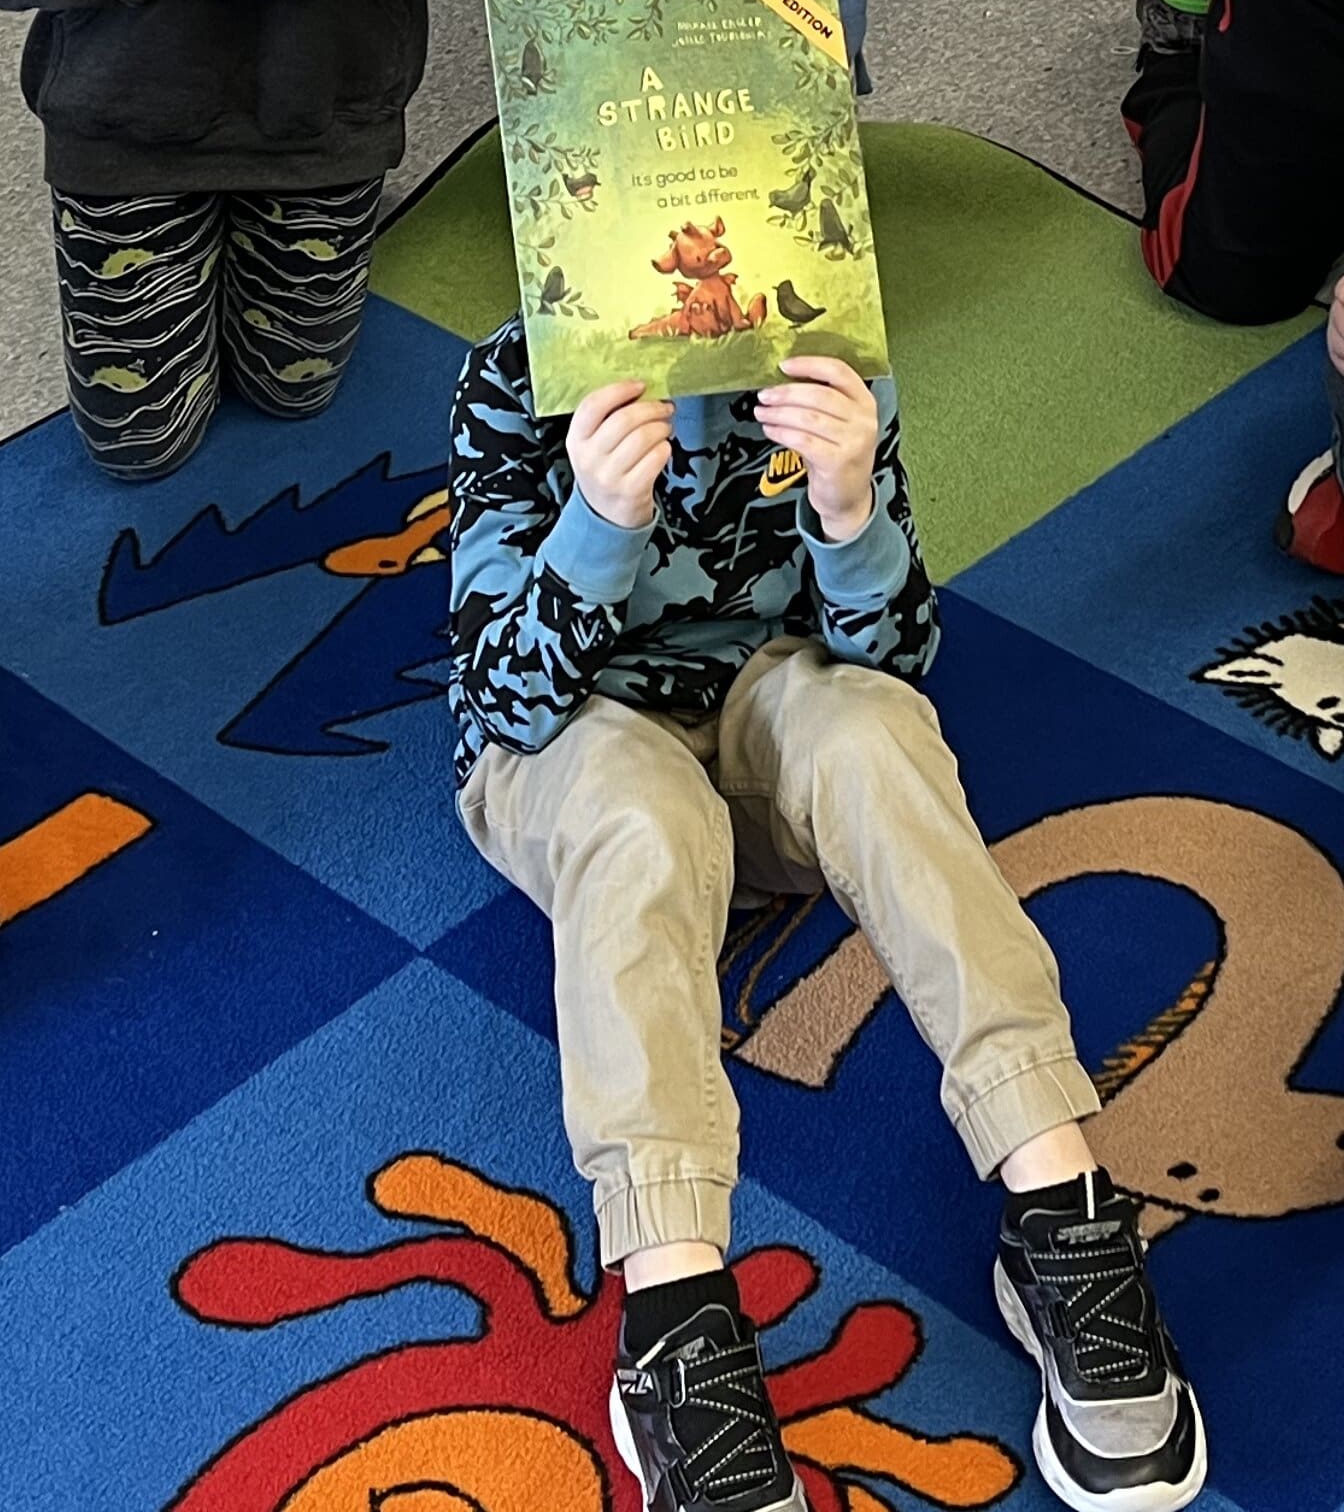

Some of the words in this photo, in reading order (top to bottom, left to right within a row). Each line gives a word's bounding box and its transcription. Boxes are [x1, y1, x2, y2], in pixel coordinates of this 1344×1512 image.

[640, 66, 664, 93] A
[596, 88, 755, 128] STRANGE
[656, 167, 696, 188] good
[700, 167, 716, 180] to
[718, 164, 738, 178] be
[657, 197, 668, 208] a
[670, 194, 691, 208] bit
[695, 188, 760, 205] different
